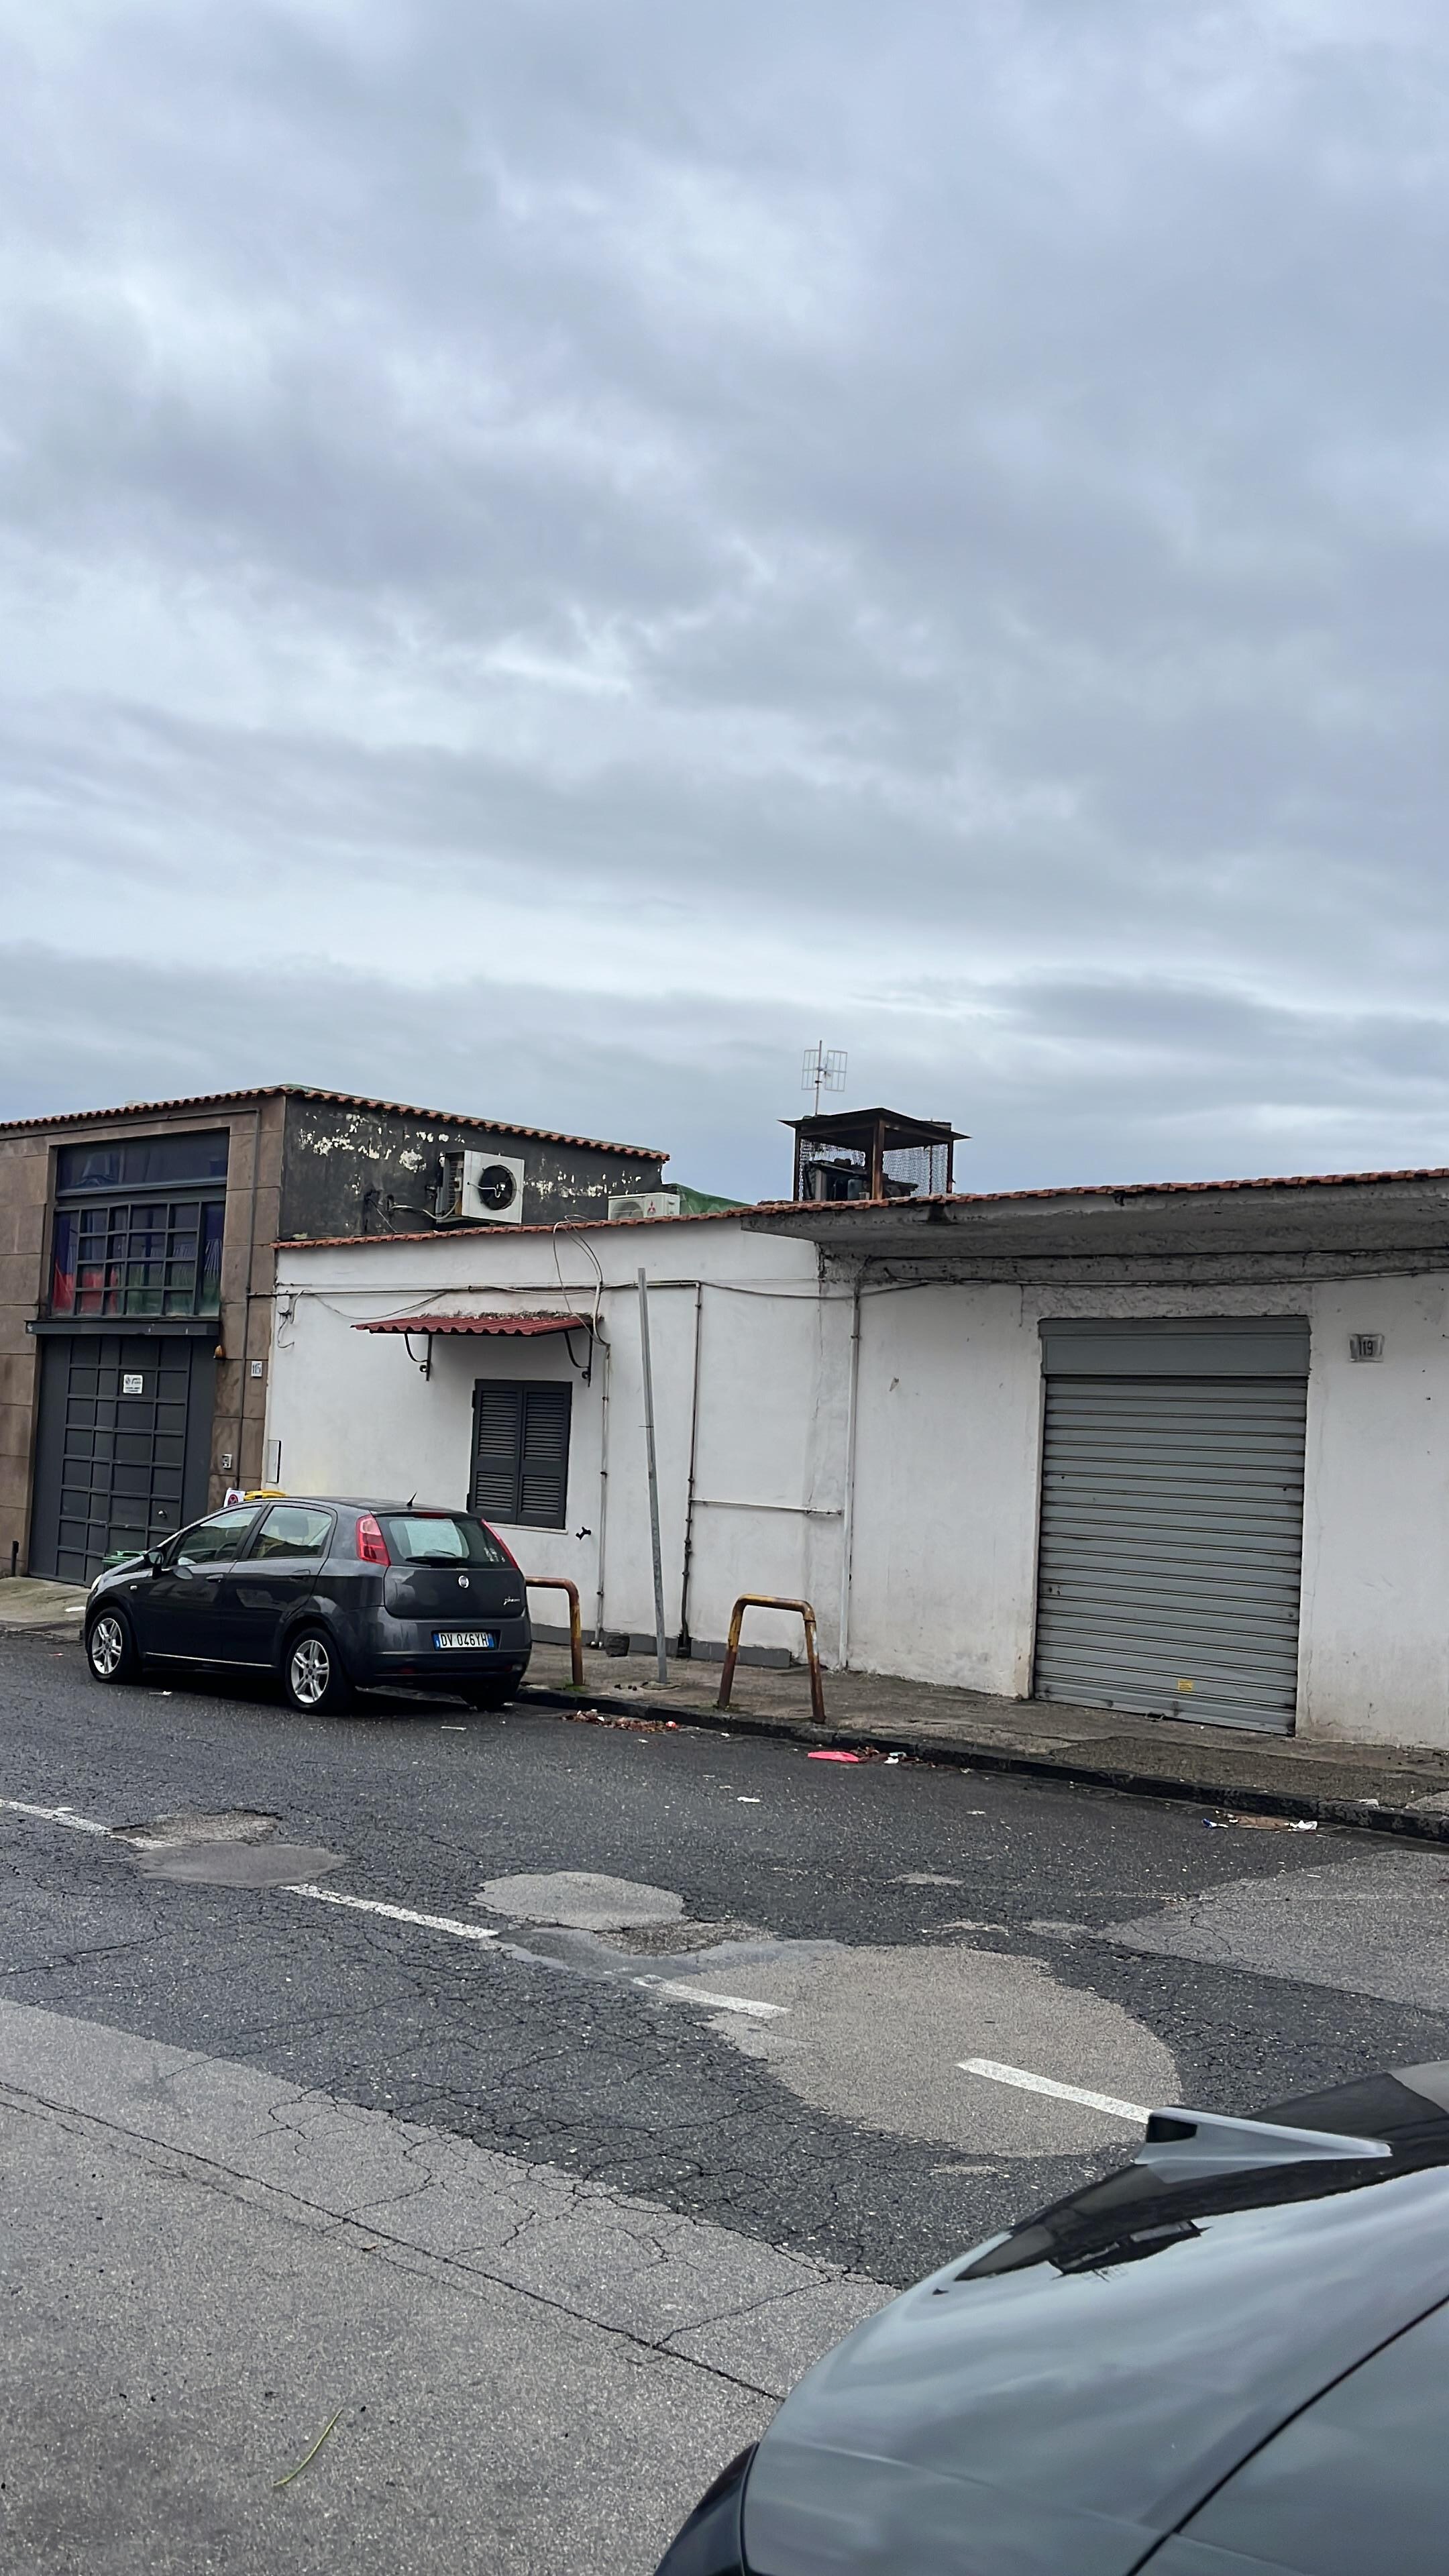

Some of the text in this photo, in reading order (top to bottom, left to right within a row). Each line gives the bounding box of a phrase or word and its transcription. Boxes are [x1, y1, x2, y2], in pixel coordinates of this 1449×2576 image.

[1358, 1340, 1374, 1356] 119
[440, 1633, 453, 1647] DV
[456, 1633, 488, 1646] 046YH
